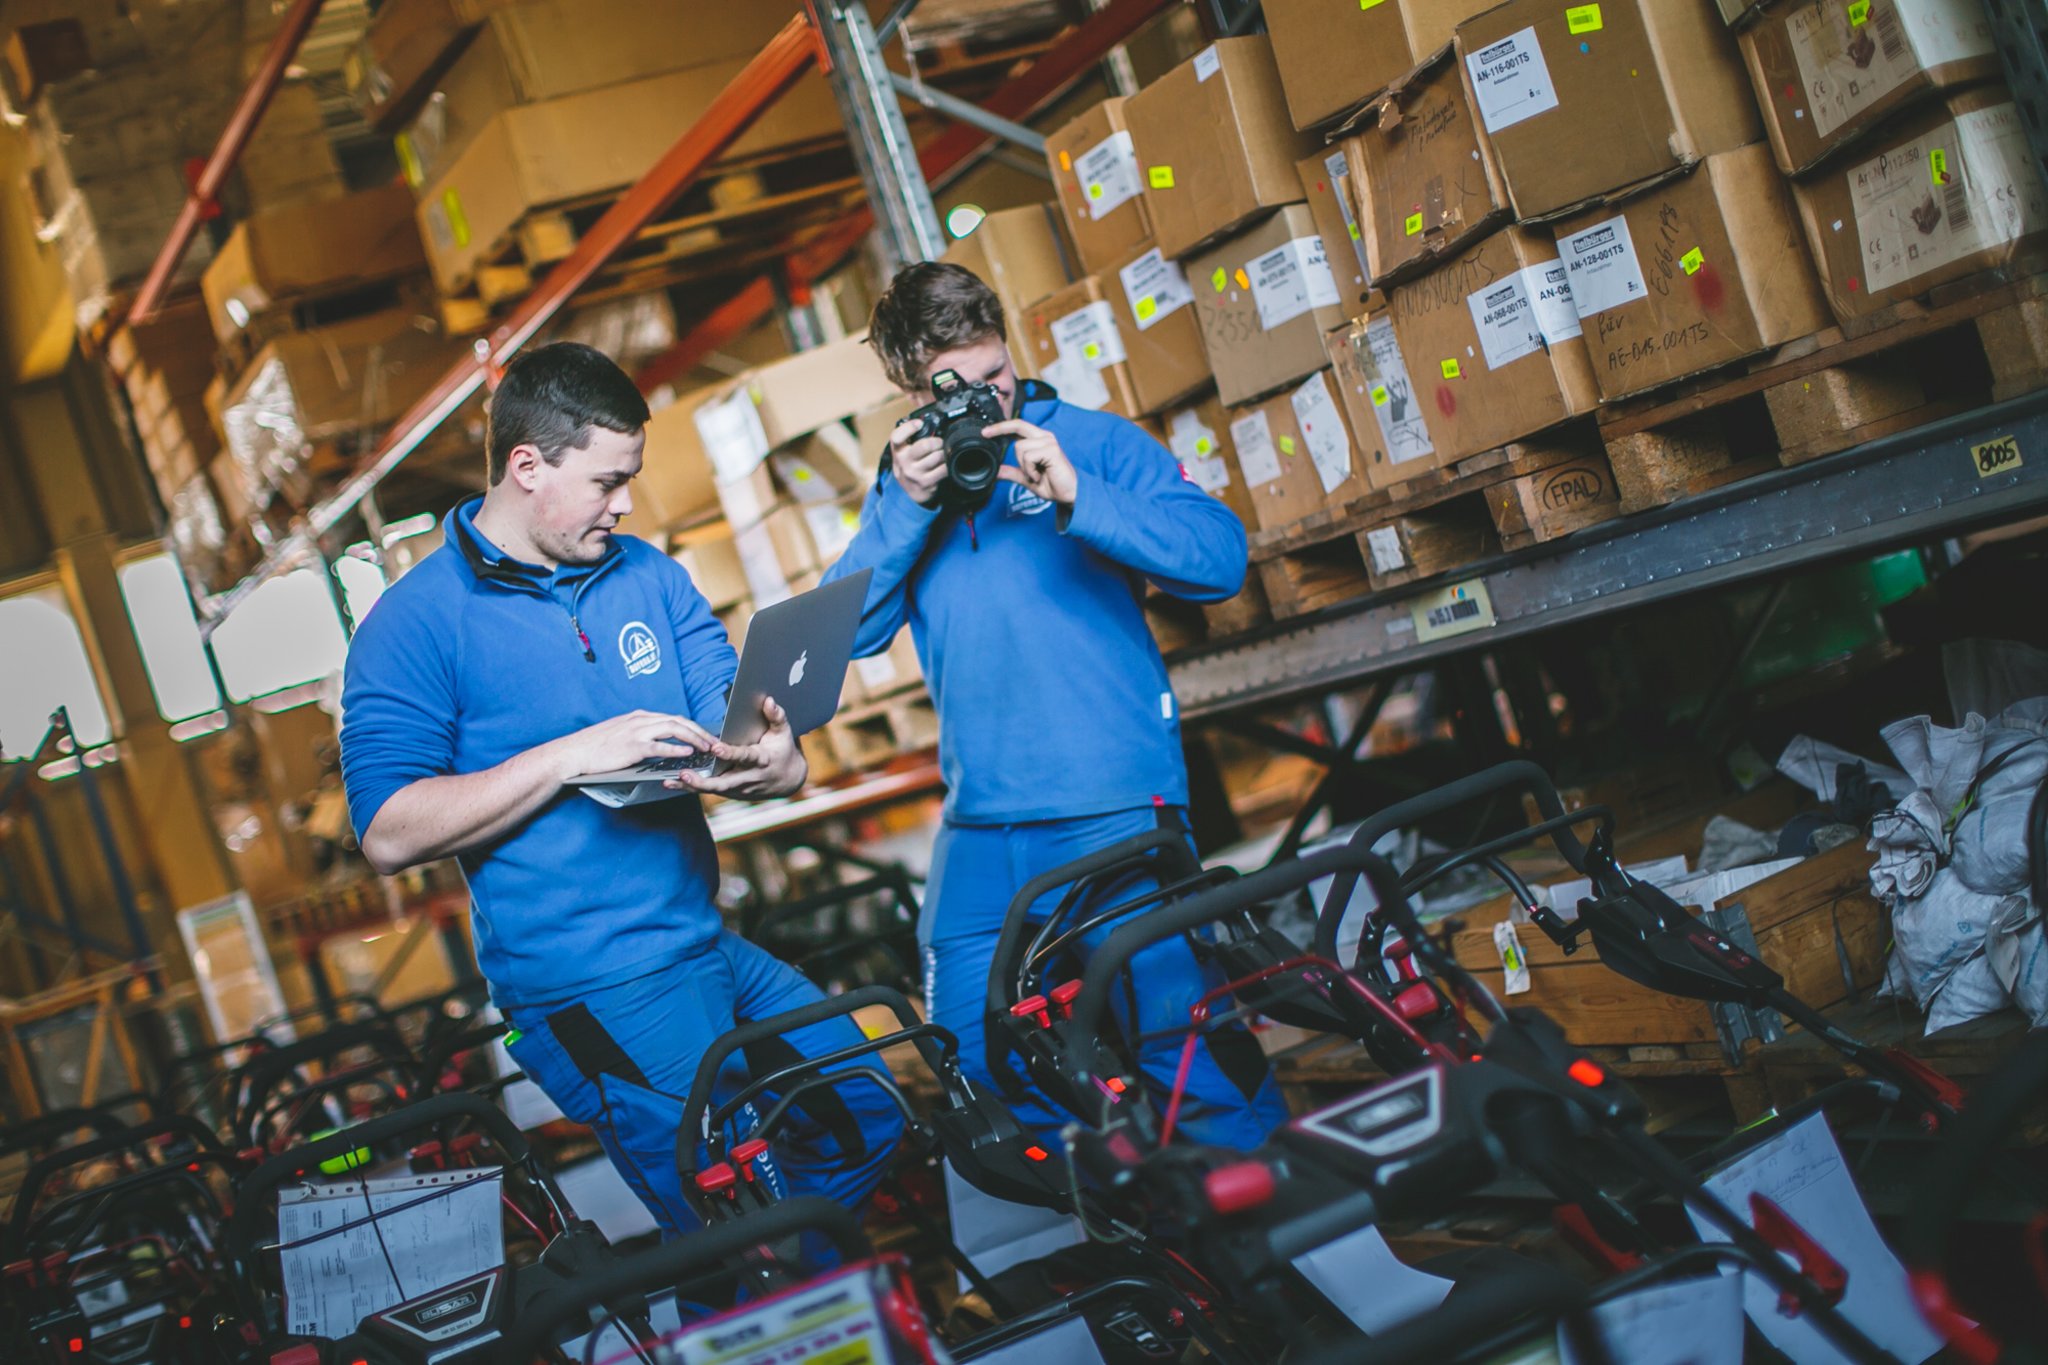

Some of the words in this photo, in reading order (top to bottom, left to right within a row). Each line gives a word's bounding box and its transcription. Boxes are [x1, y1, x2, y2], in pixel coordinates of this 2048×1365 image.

[1477, 51, 1530, 82] AN-116-001TS
[1570, 244, 1624, 272] AN-128-001TS
[1484, 297, 1528, 326] AN-068-001TS
[1979, 438, 2016, 472] 8005
[1551, 475, 1597, 508] EPAL
